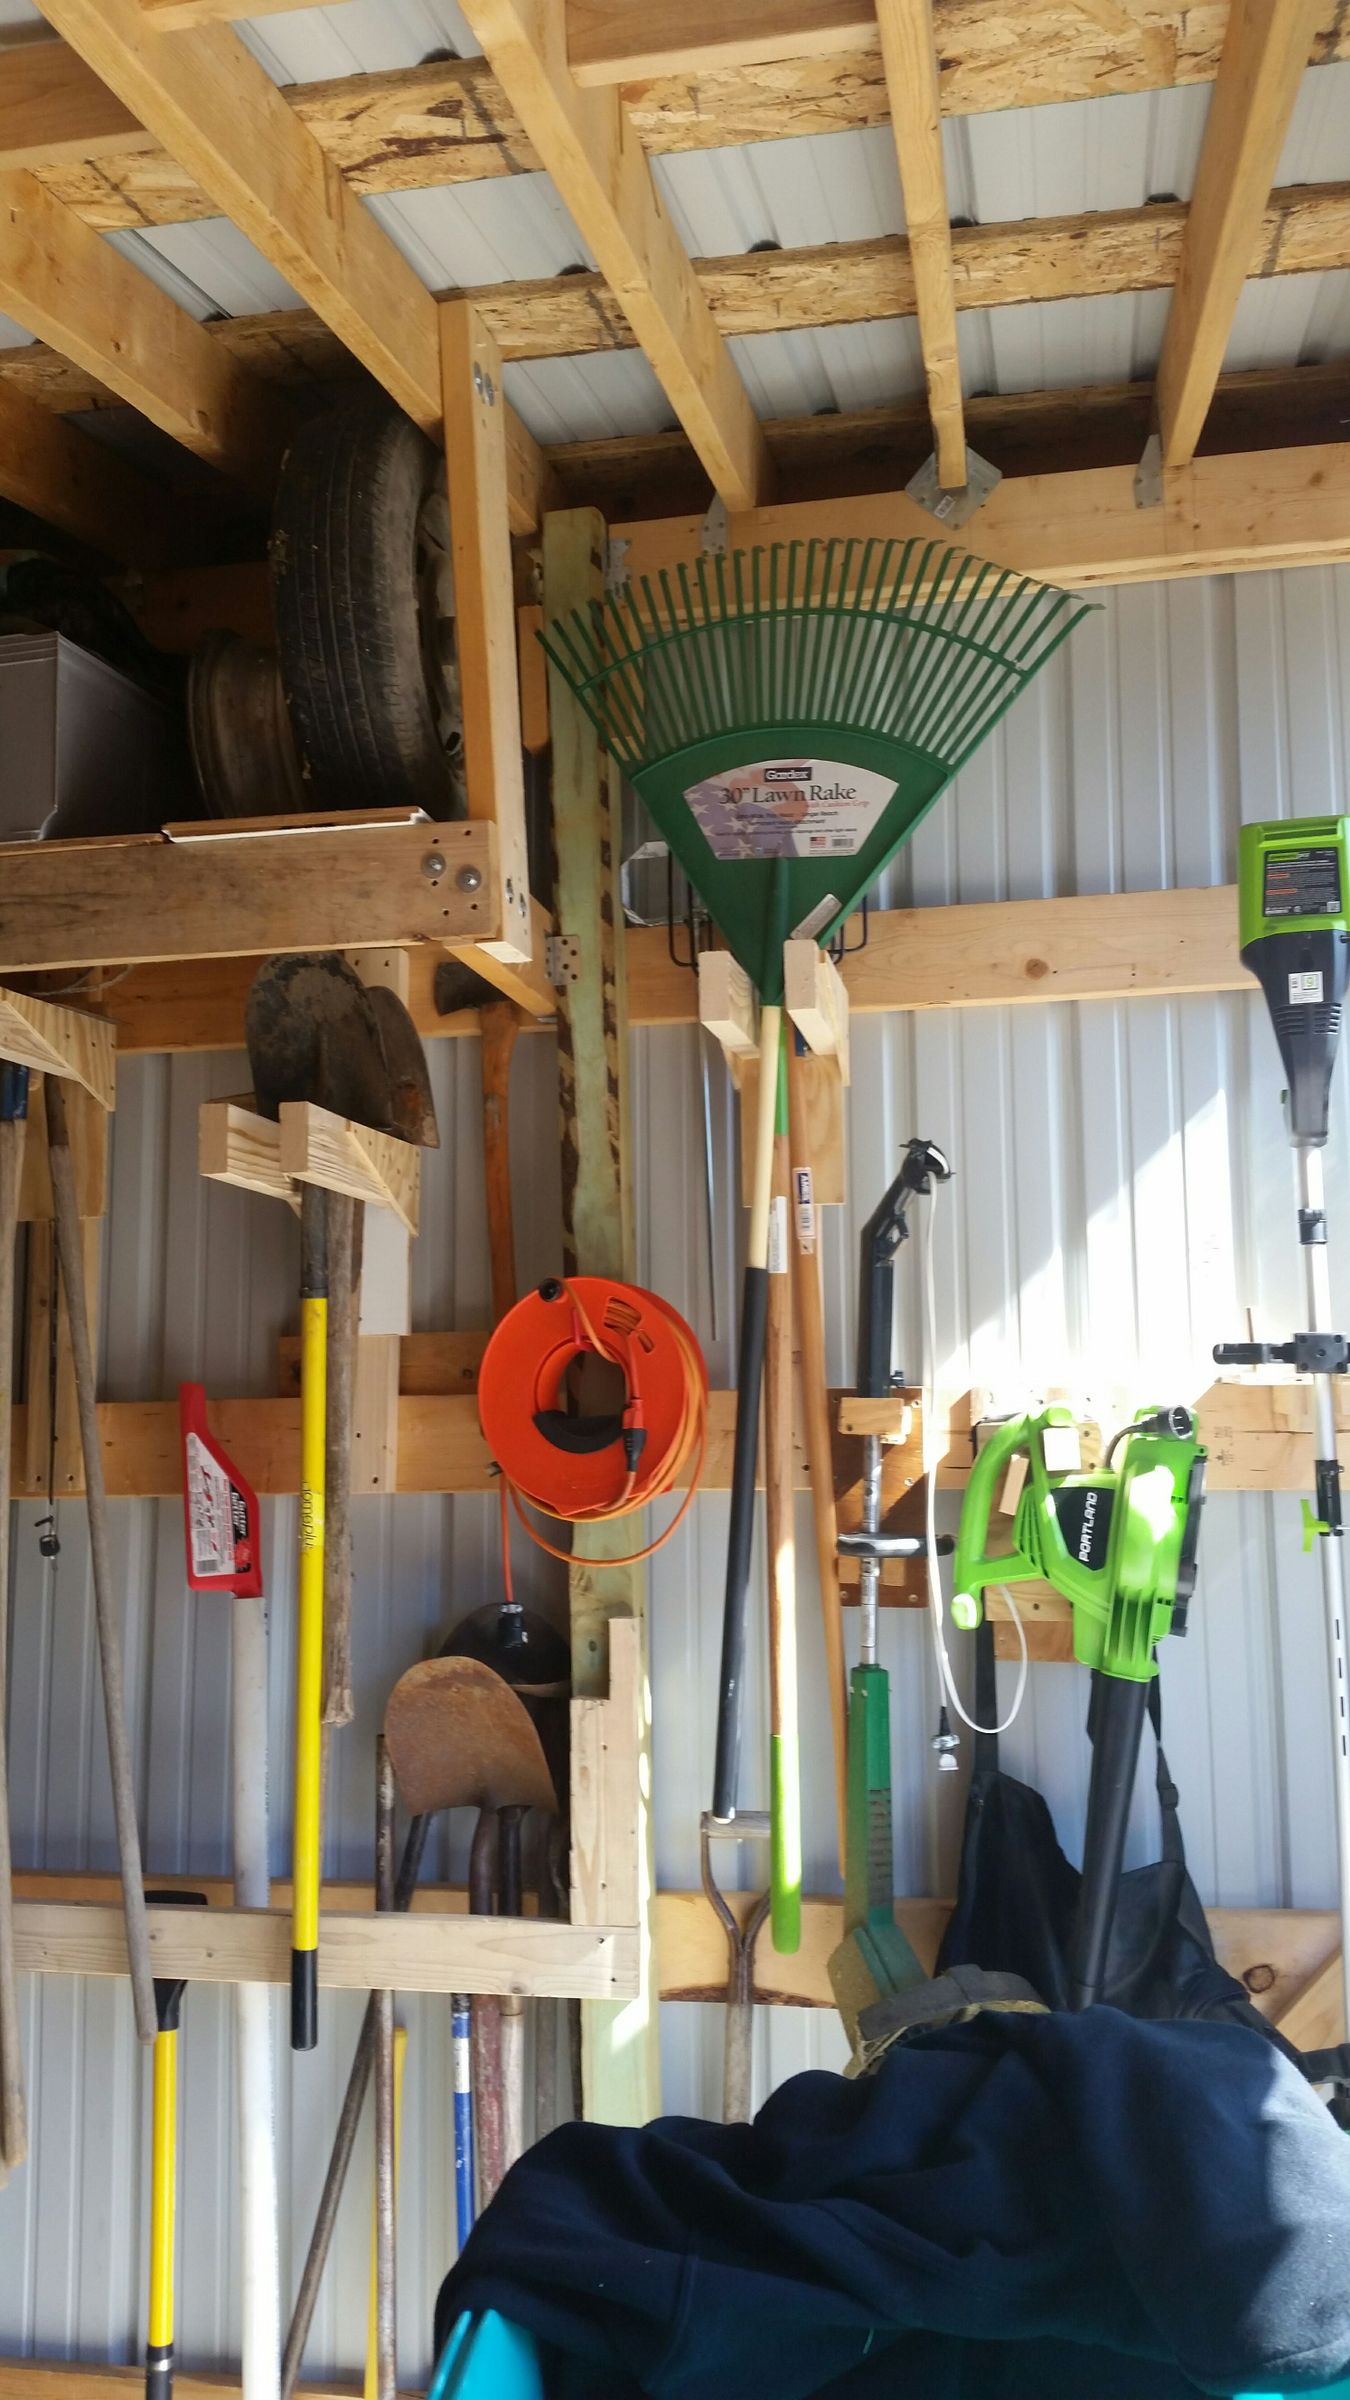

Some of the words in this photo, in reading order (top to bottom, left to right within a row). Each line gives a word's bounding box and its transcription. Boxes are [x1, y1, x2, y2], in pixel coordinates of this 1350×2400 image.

[752, 788, 806, 802] Lawn
[810, 783, 857, 801] Rake
[1078, 1492, 1098, 1562] PORTLAND
